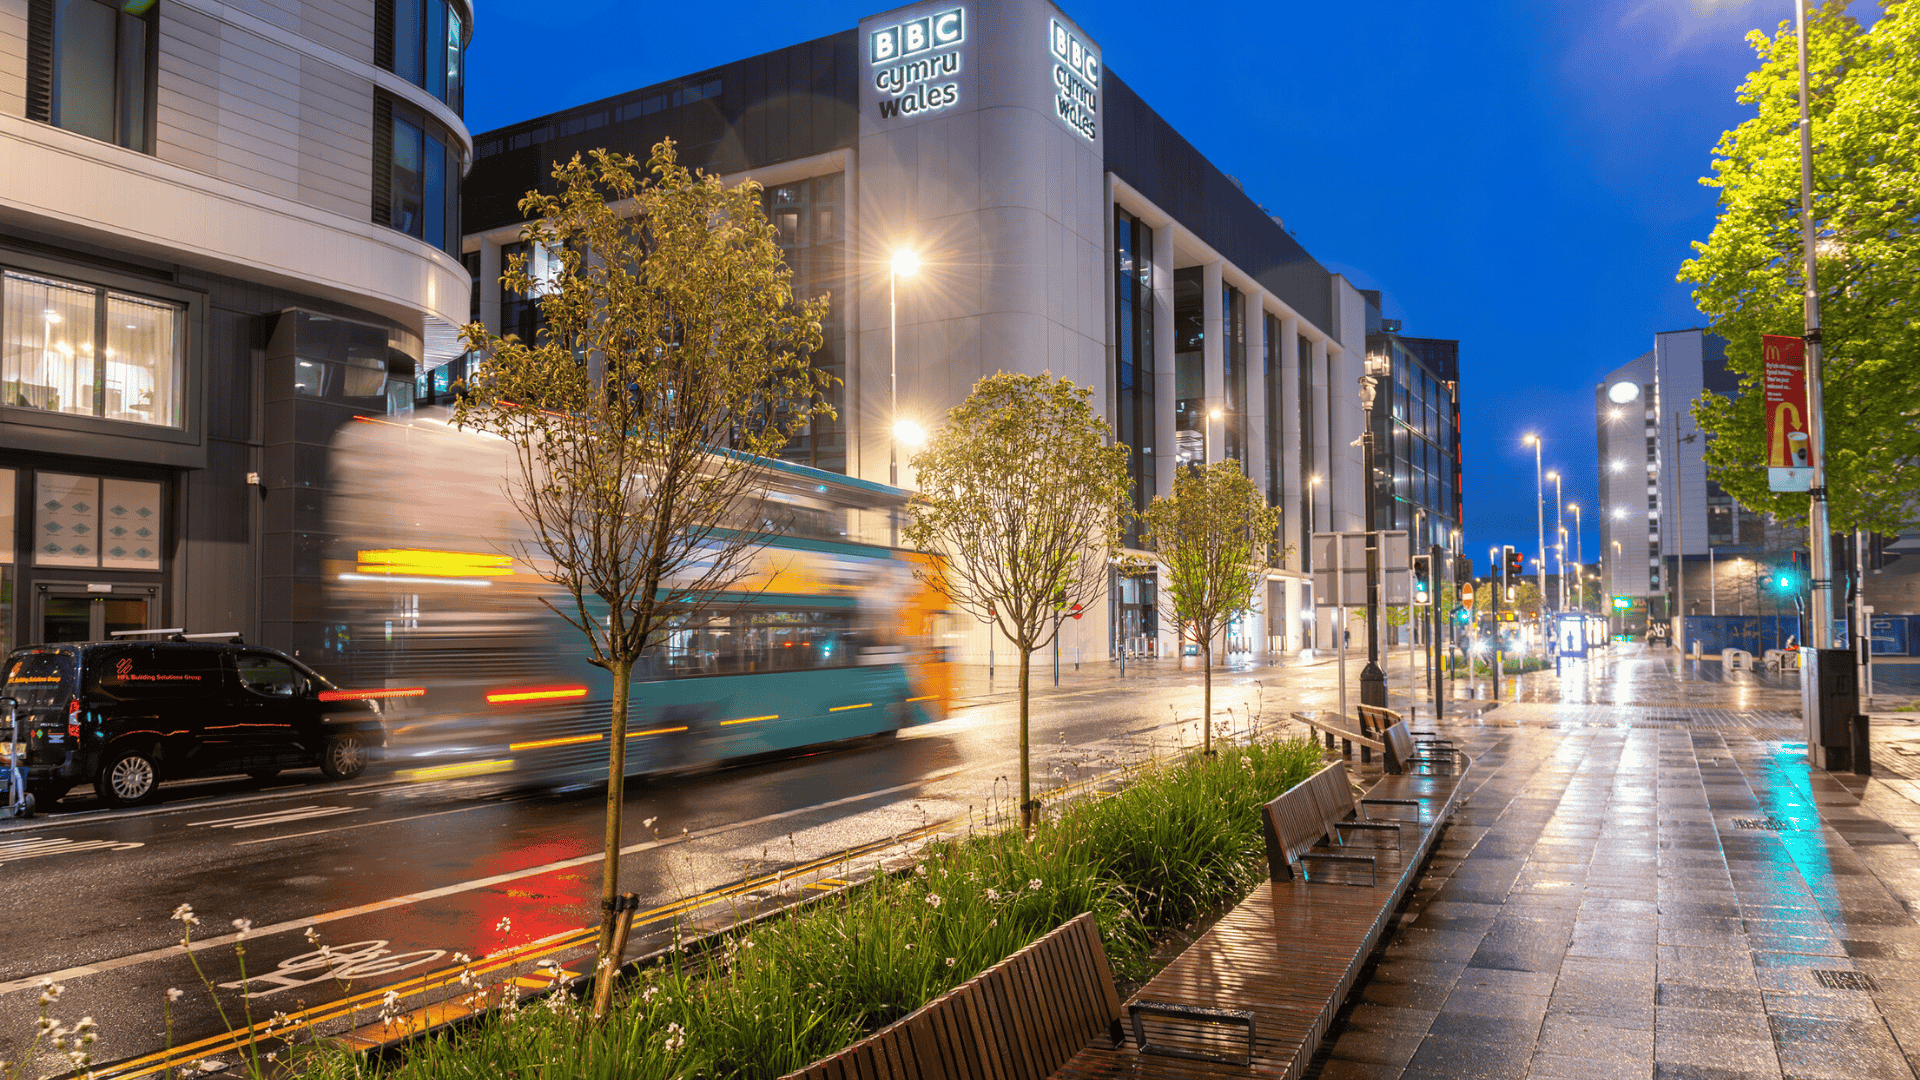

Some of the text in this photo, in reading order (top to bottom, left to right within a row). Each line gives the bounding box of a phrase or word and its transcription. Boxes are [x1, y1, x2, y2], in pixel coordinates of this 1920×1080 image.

[874, 12, 960, 61] BBC
[1055, 22, 1098, 85] BBC
[876, 52, 959, 93] cymru
[1054, 65, 1097, 113] cymru
[878, 84, 957, 119] wales
[1055, 94, 1096, 141] wales
[131, 674, 155, 682] Building
[157, 673, 183, 681] Solutions
[184, 674, 201, 682] Group
